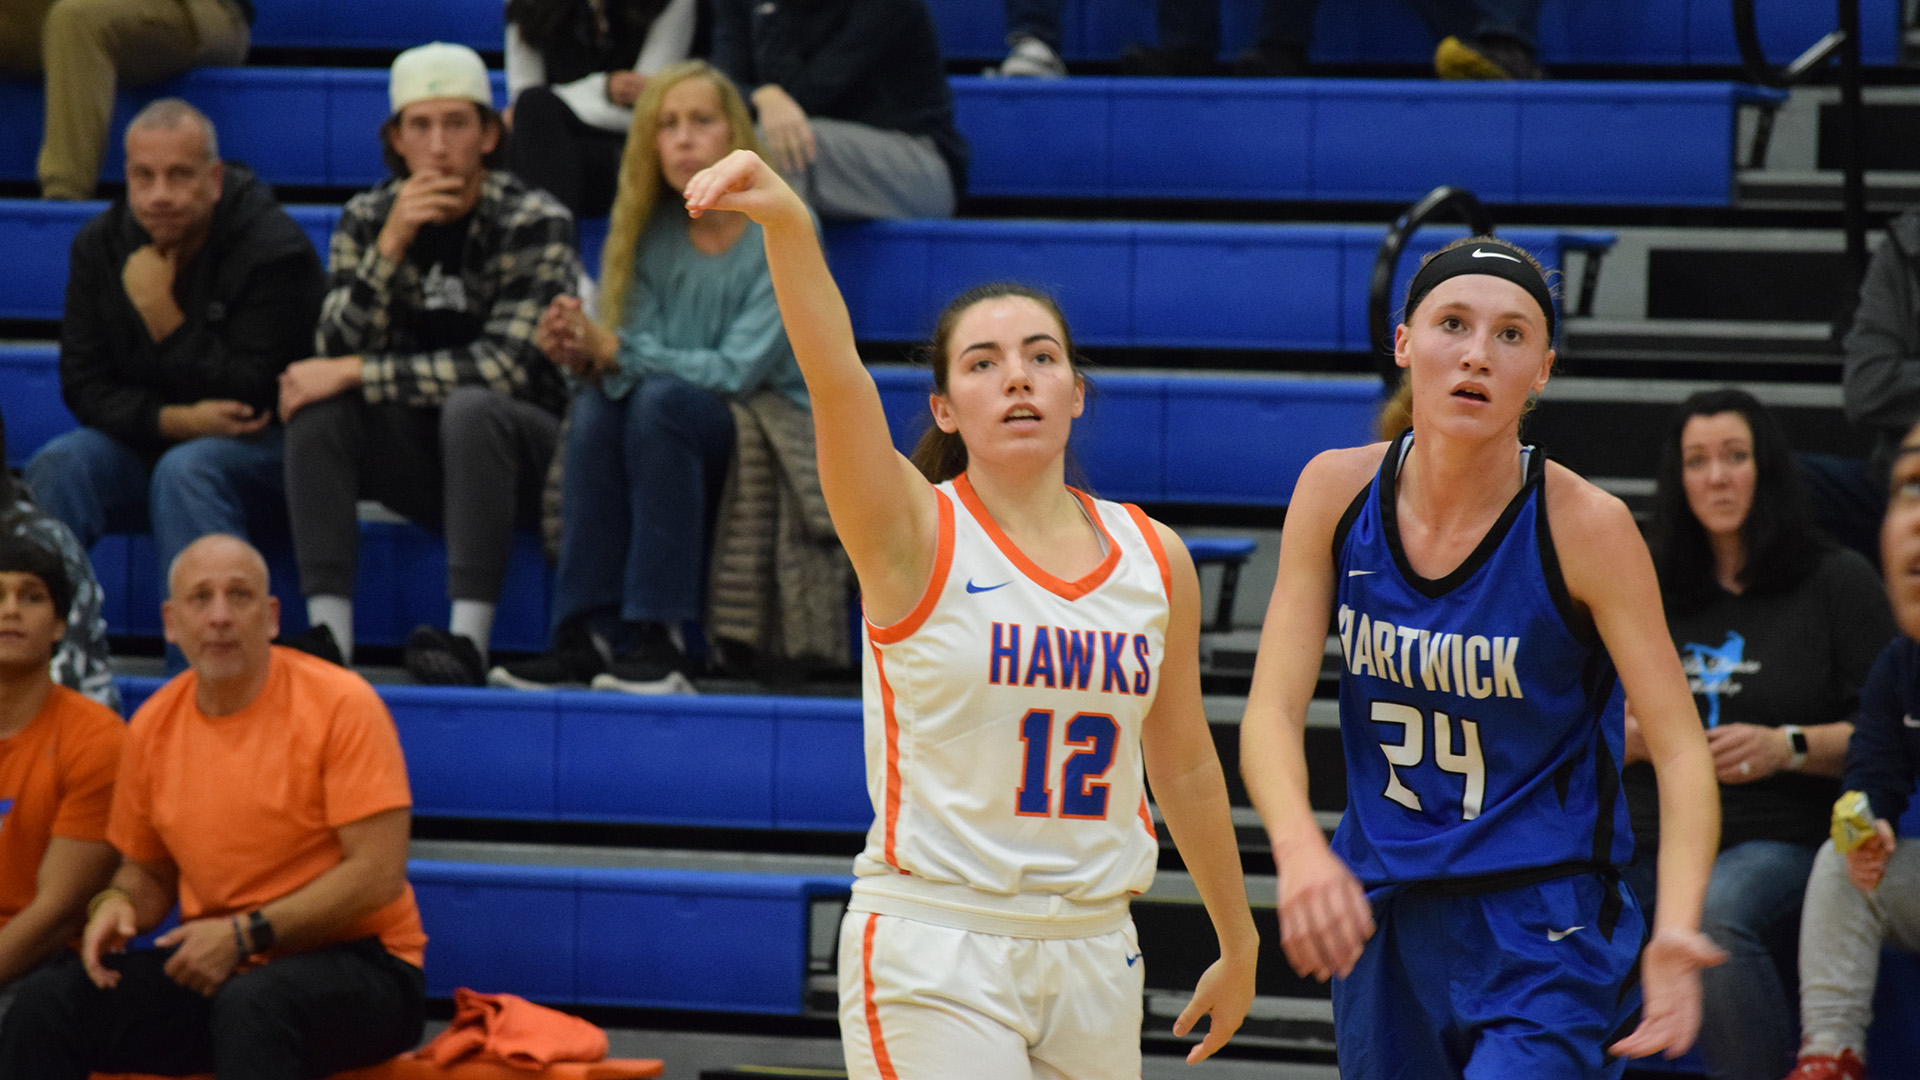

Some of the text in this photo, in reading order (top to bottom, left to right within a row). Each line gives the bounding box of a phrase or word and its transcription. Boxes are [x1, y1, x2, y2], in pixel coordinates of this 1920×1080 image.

[989, 621, 1150, 697] HAWKS
[1015, 708, 1121, 820] 12
[1370, 701, 1486, 821] 24
